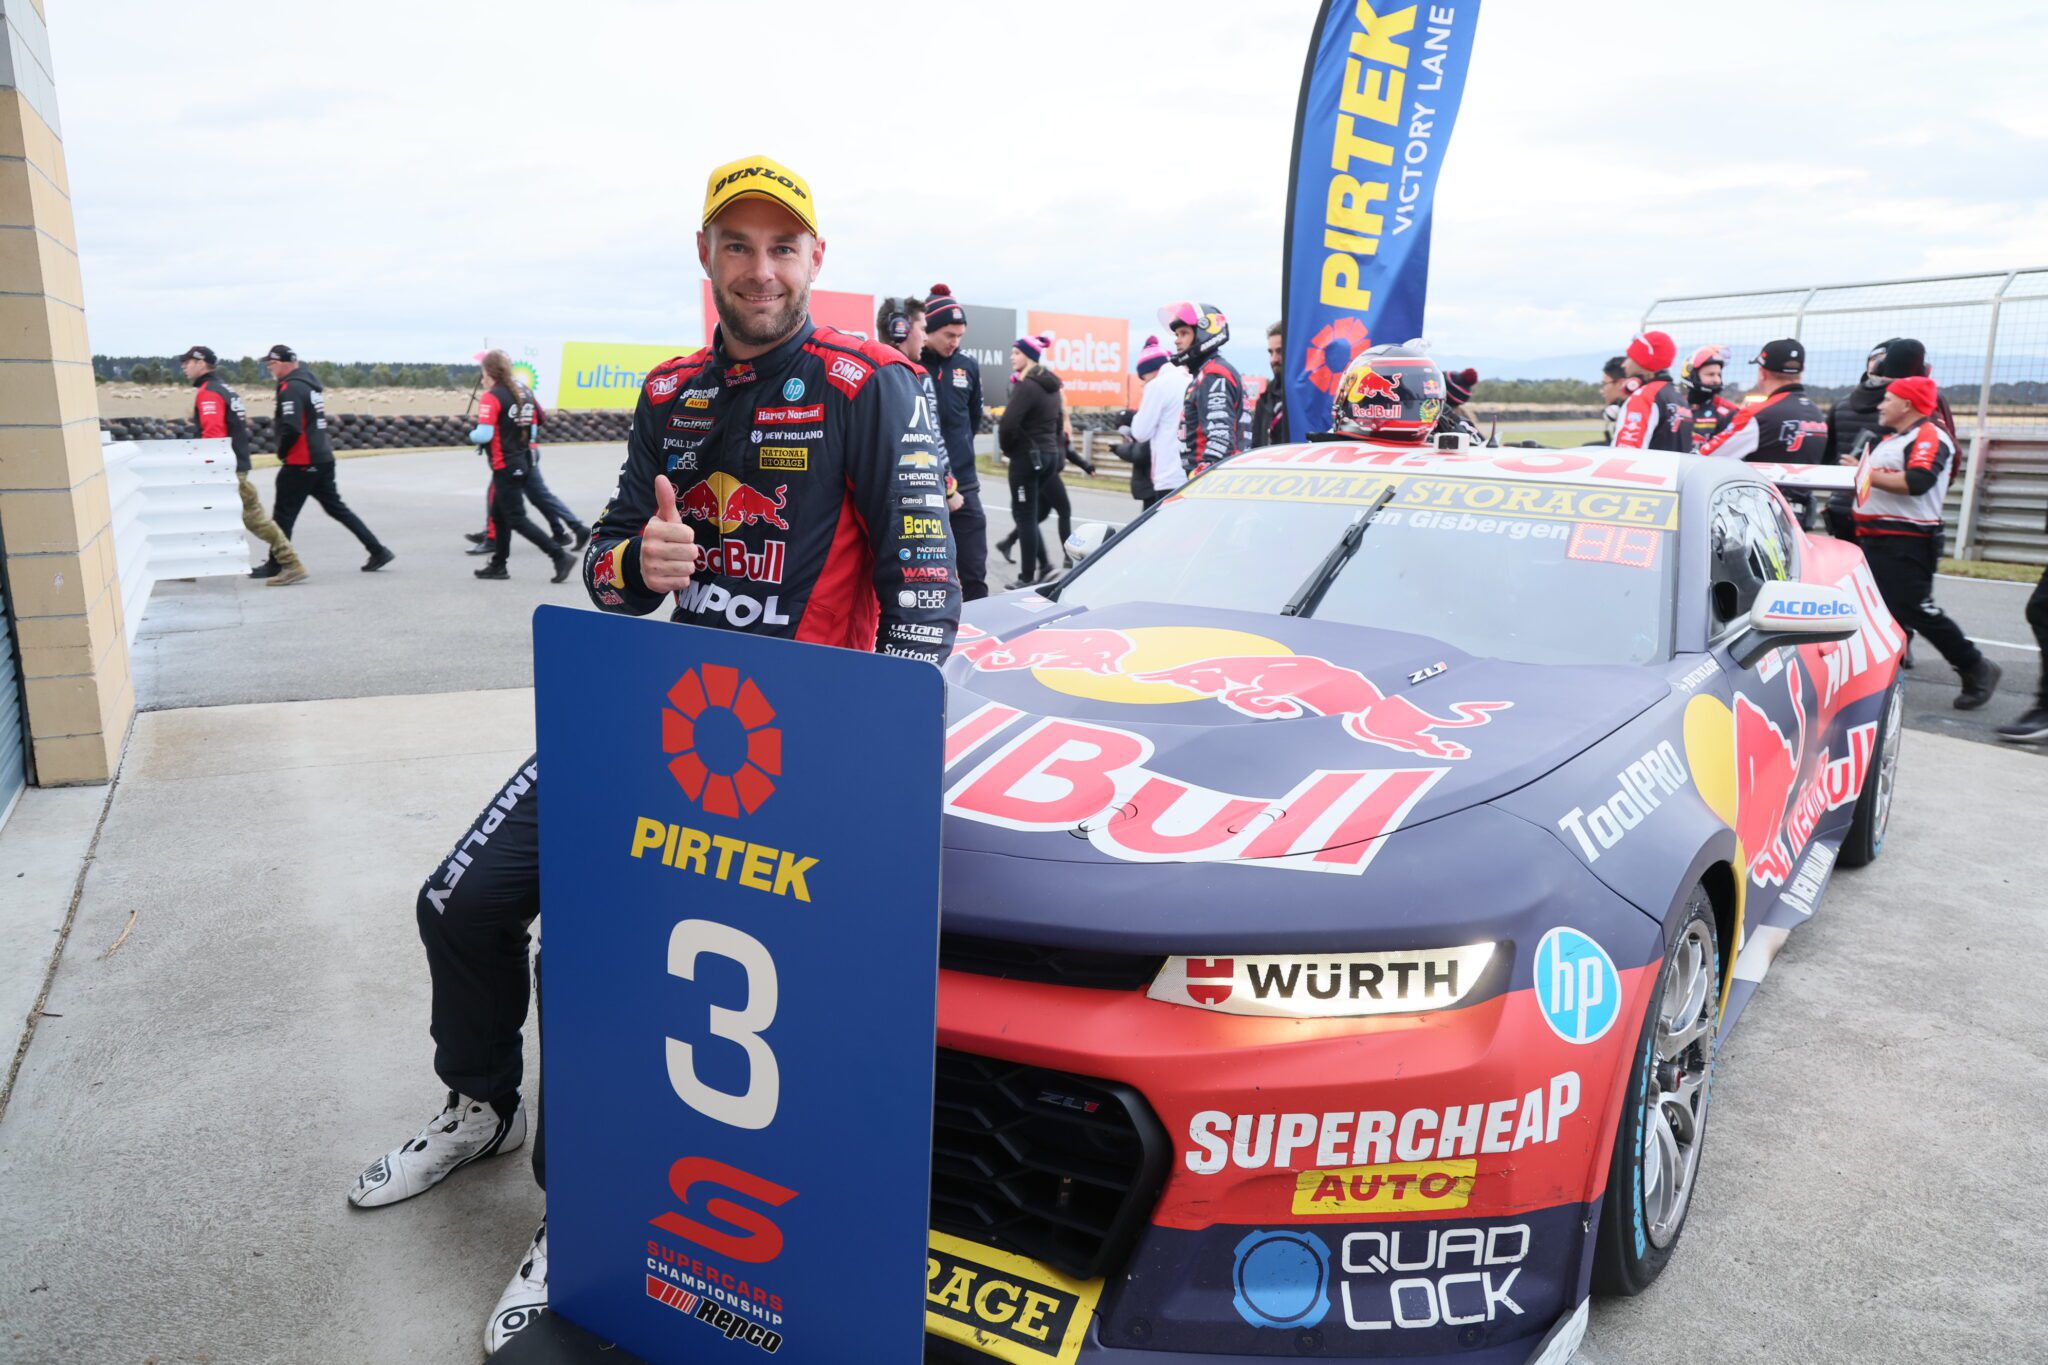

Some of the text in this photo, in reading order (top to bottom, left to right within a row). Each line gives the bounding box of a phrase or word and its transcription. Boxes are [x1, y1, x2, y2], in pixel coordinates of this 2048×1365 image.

[1392, 5, 1455, 236] VICTORY LANE
[1320, 0, 1417, 311] PIRTEK
[713, 166, 807, 199] DUNLOP
[652, 376, 678, 393] OMP
[832, 360, 863, 381] OMP
[786, 380, 802, 400] hp
[758, 407, 819, 422] Harvey Norman
[1352, 403, 1402, 418] Red Bull
[764, 430, 823, 440] NEW HOLLAND
[901, 433, 934, 444] AMPOL
[761, 448, 805, 457] NATIONAL
[763, 458, 804, 467] STORAGE
[1187, 472, 1661, 523] NATIONAL STORAGE
[904, 516, 943, 535] Baron
[1408, 510, 1571, 541] Gisbergen
[723, 538, 785, 584] Bull
[902, 566, 948, 577] WARD
[678, 580, 790, 628] MPOL
[918, 590, 946, 599] QUAD
[918, 600, 945, 609] LOCK
[1767, 600, 1858, 616] ACDelco
[883, 643, 939, 662] Suttons
[1685, 657, 1720, 690] DUNLOP
[944, 715, 1453, 877] Bull
[1557, 739, 1689, 863] ToolPRO
[630, 816, 820, 903] PIRTEK
[1246, 960, 1459, 999] WÜRTH
[1551, 931, 1604, 1040] hp
[665, 919, 779, 1131] 3
[1185, 1071, 1582, 1175] SUPERCHEAP
[1310, 1172, 1461, 1202] AUTO
[1341, 1222, 1532, 1275] QUAD
[646, 1240, 784, 1312] SUPERCARS
[646, 1257, 783, 1326] CHAMPIONSHIP
[1341, 1267, 1526, 1331] LOCK
[694, 1295, 784, 1355] Repco
